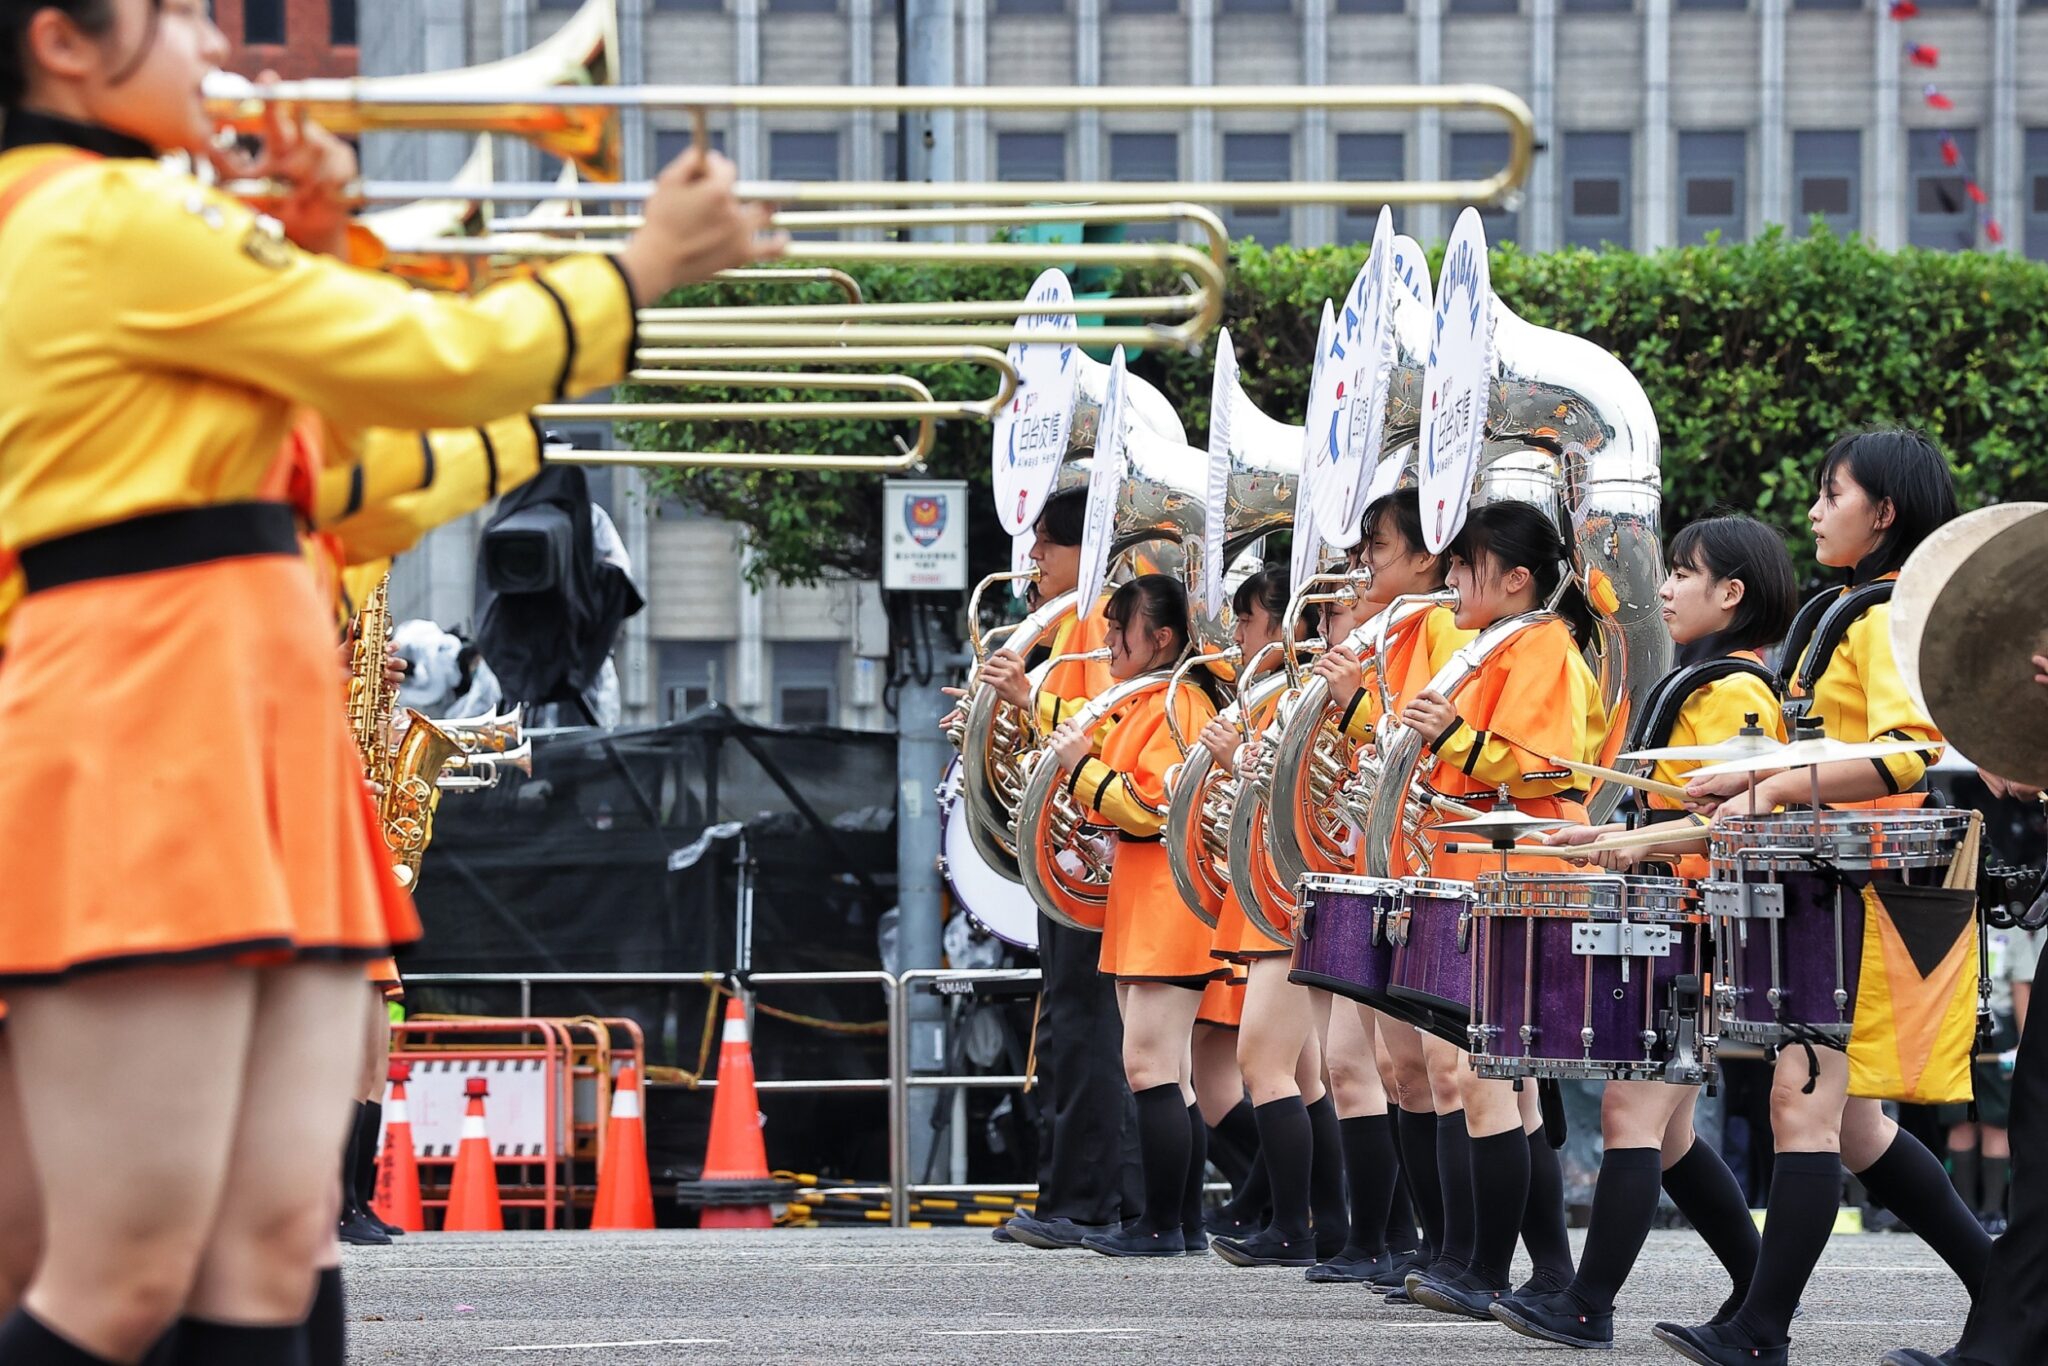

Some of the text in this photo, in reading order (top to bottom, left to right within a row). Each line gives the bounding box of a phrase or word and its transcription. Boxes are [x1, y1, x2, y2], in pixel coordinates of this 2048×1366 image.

[1429, 240, 1479, 368] TACHIBANA
[1019, 411, 1062, 450] 日台友情
[1438, 388, 1471, 456] 日台友情
